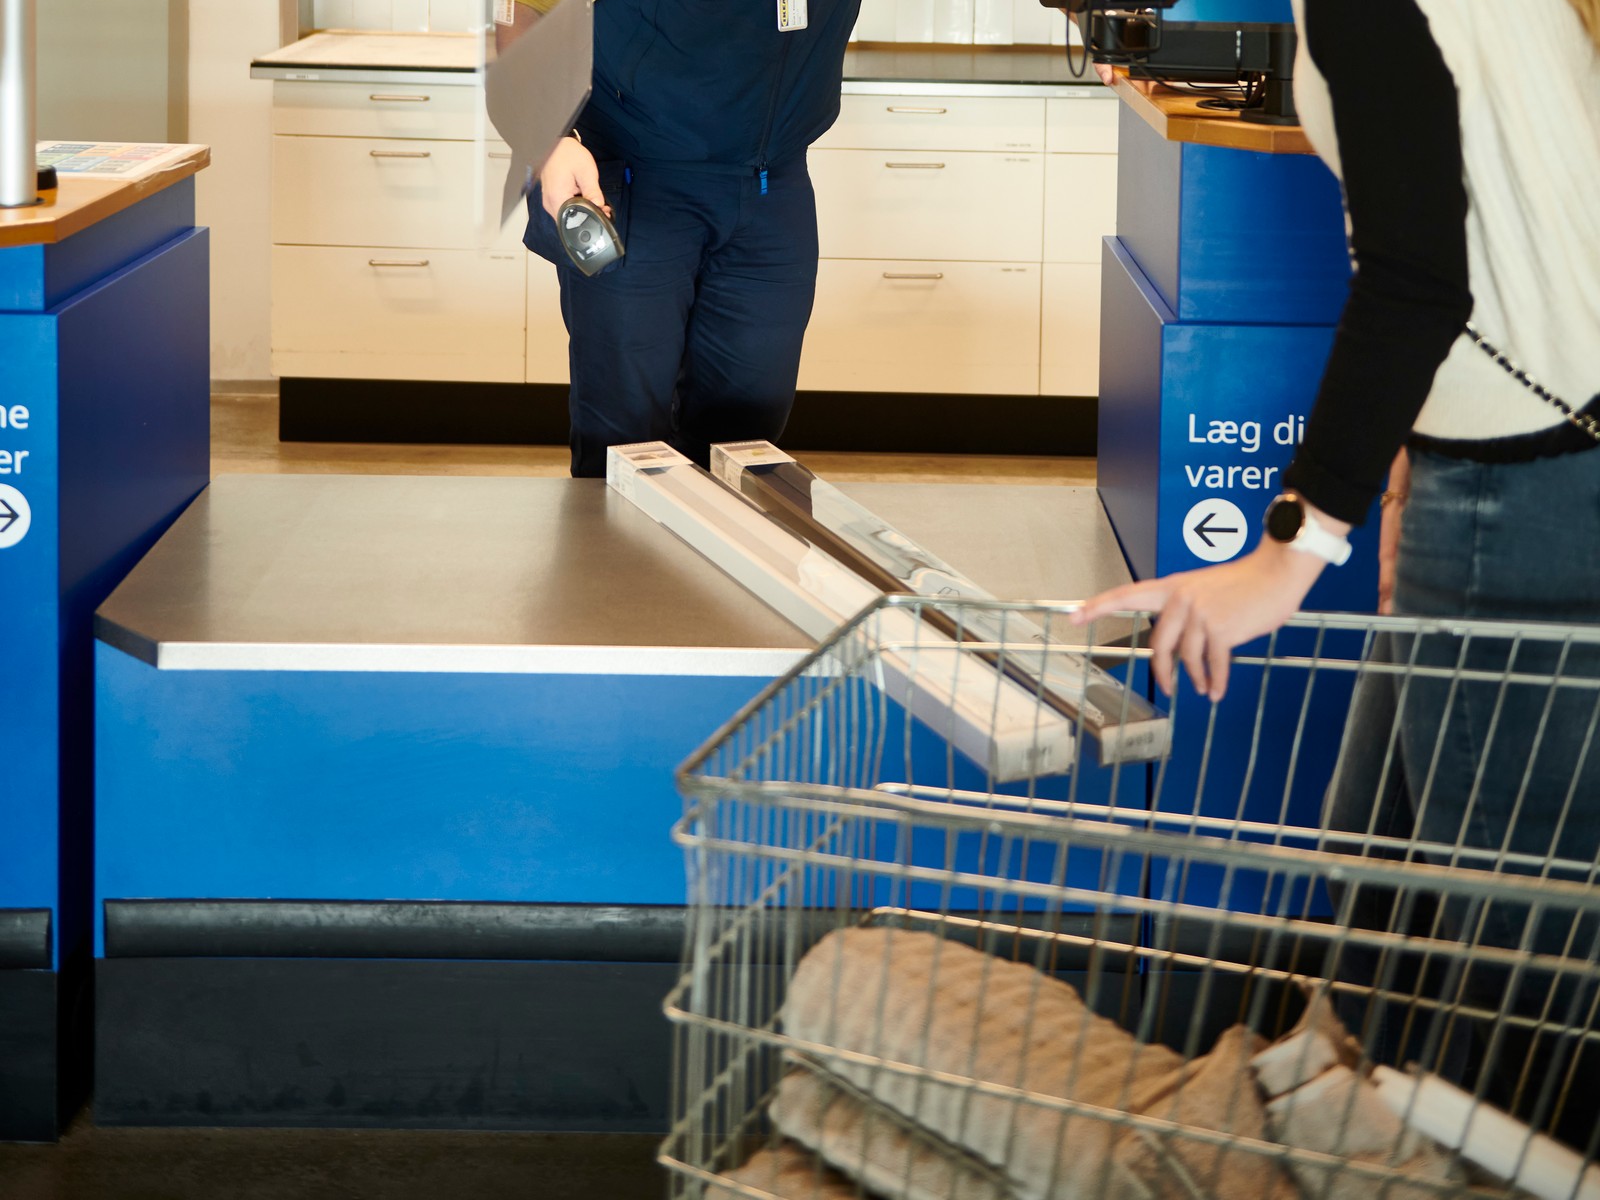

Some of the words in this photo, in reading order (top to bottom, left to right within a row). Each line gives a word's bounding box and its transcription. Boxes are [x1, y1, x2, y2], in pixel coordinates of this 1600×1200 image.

[1188, 413, 1262, 453] Læg
[1273, 414, 1305, 445] di
[0, 449, 30, 475] er
[1184, 464, 1279, 490] varer
